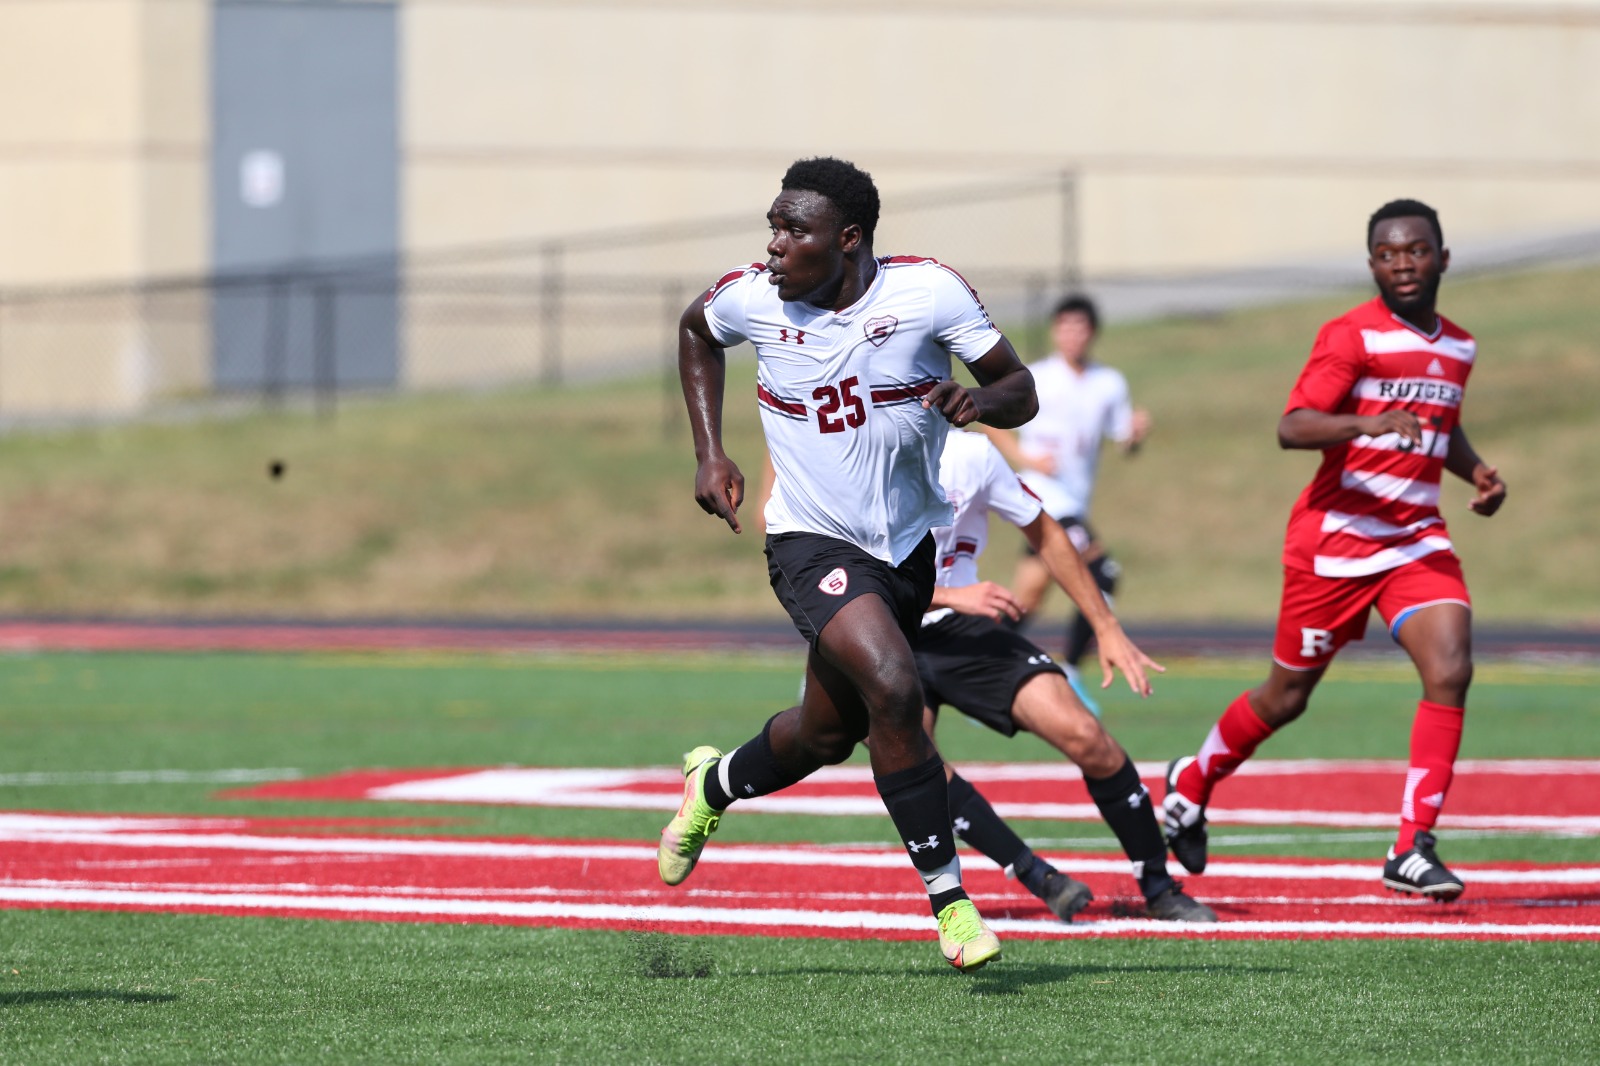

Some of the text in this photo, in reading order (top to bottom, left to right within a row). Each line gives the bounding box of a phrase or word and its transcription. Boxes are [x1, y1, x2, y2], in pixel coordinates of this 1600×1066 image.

[812, 376, 866, 434] 25
[829, 578, 843, 591] S
[1300, 627, 1334, 657] R
